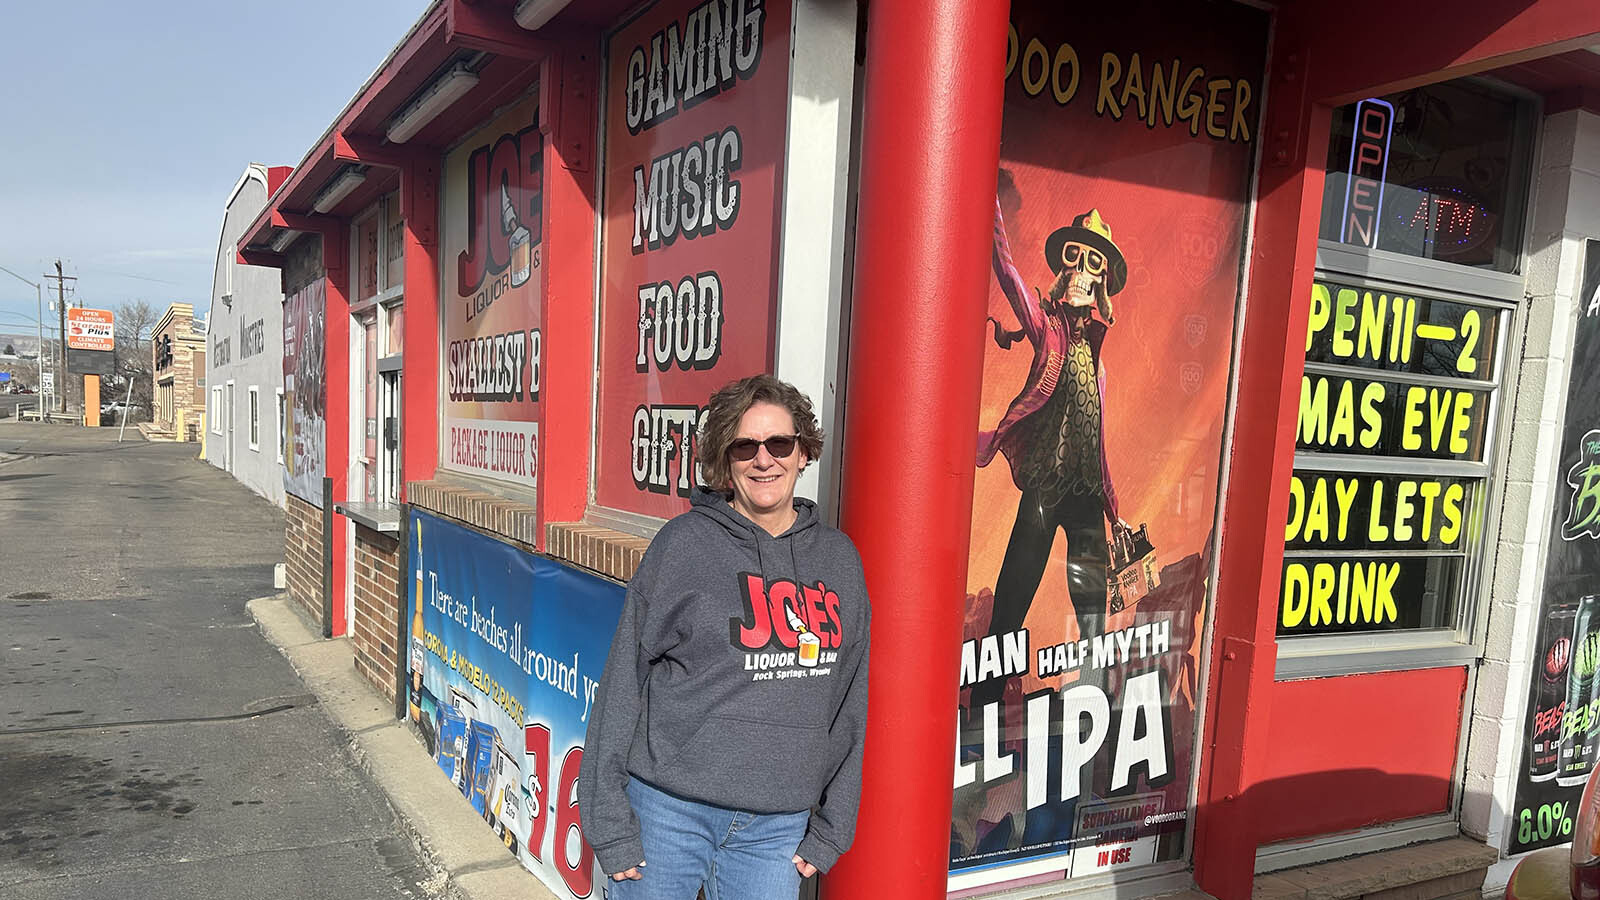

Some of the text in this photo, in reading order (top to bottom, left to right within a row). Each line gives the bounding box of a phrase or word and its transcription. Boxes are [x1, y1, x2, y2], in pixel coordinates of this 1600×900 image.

[625, 0, 766, 134] GAMING
[1096, 52, 1251, 141] RANGER
[632, 125, 742, 255] MUSIC
[1347, 108, 1386, 247] OPEN
[1409, 196, 1476, 237] ATM
[466, 250, 541, 323] LIQUOR &
[71, 321, 111, 331] Storage
[87, 328, 110, 336] Plus
[636, 270, 724, 373] FOOD
[449, 330, 526, 402] SMALLEST
[451, 427, 488, 470] PACKAGE
[491, 430, 526, 477] LIQUOR
[1402, 387, 1474, 454] EVE
[1284, 476, 1464, 545] DAY LETS
[729, 571, 843, 652] JOE'S
[1282, 561, 1400, 628] DRINK
[428, 570, 453, 618] There
[454, 601, 468, 629] are
[471, 595, 508, 654] beaches
[509, 621, 522, 667] all
[523, 652, 578, 700] around
[744, 651, 796, 671] LIQUOR
[819, 652, 827, 664] &
[1037, 644, 1087, 678] HALF
[1092, 619, 1169, 671] MYTH
[450, 649, 457, 670] &
[458, 653, 490, 697] MODELO
[491, 679, 499, 706] 12
[500, 685, 524, 730] PACKS
[752, 670, 774, 682] Rock
[776, 667, 808, 680] Springs,
[1026, 670, 1168, 811] IPA
[1082, 803, 1157, 830] SURVEILLANCE
[1518, 801, 1572, 844] 6.0%
[1097, 850, 1109, 868] IN
[1111, 847, 1132, 865] USE
